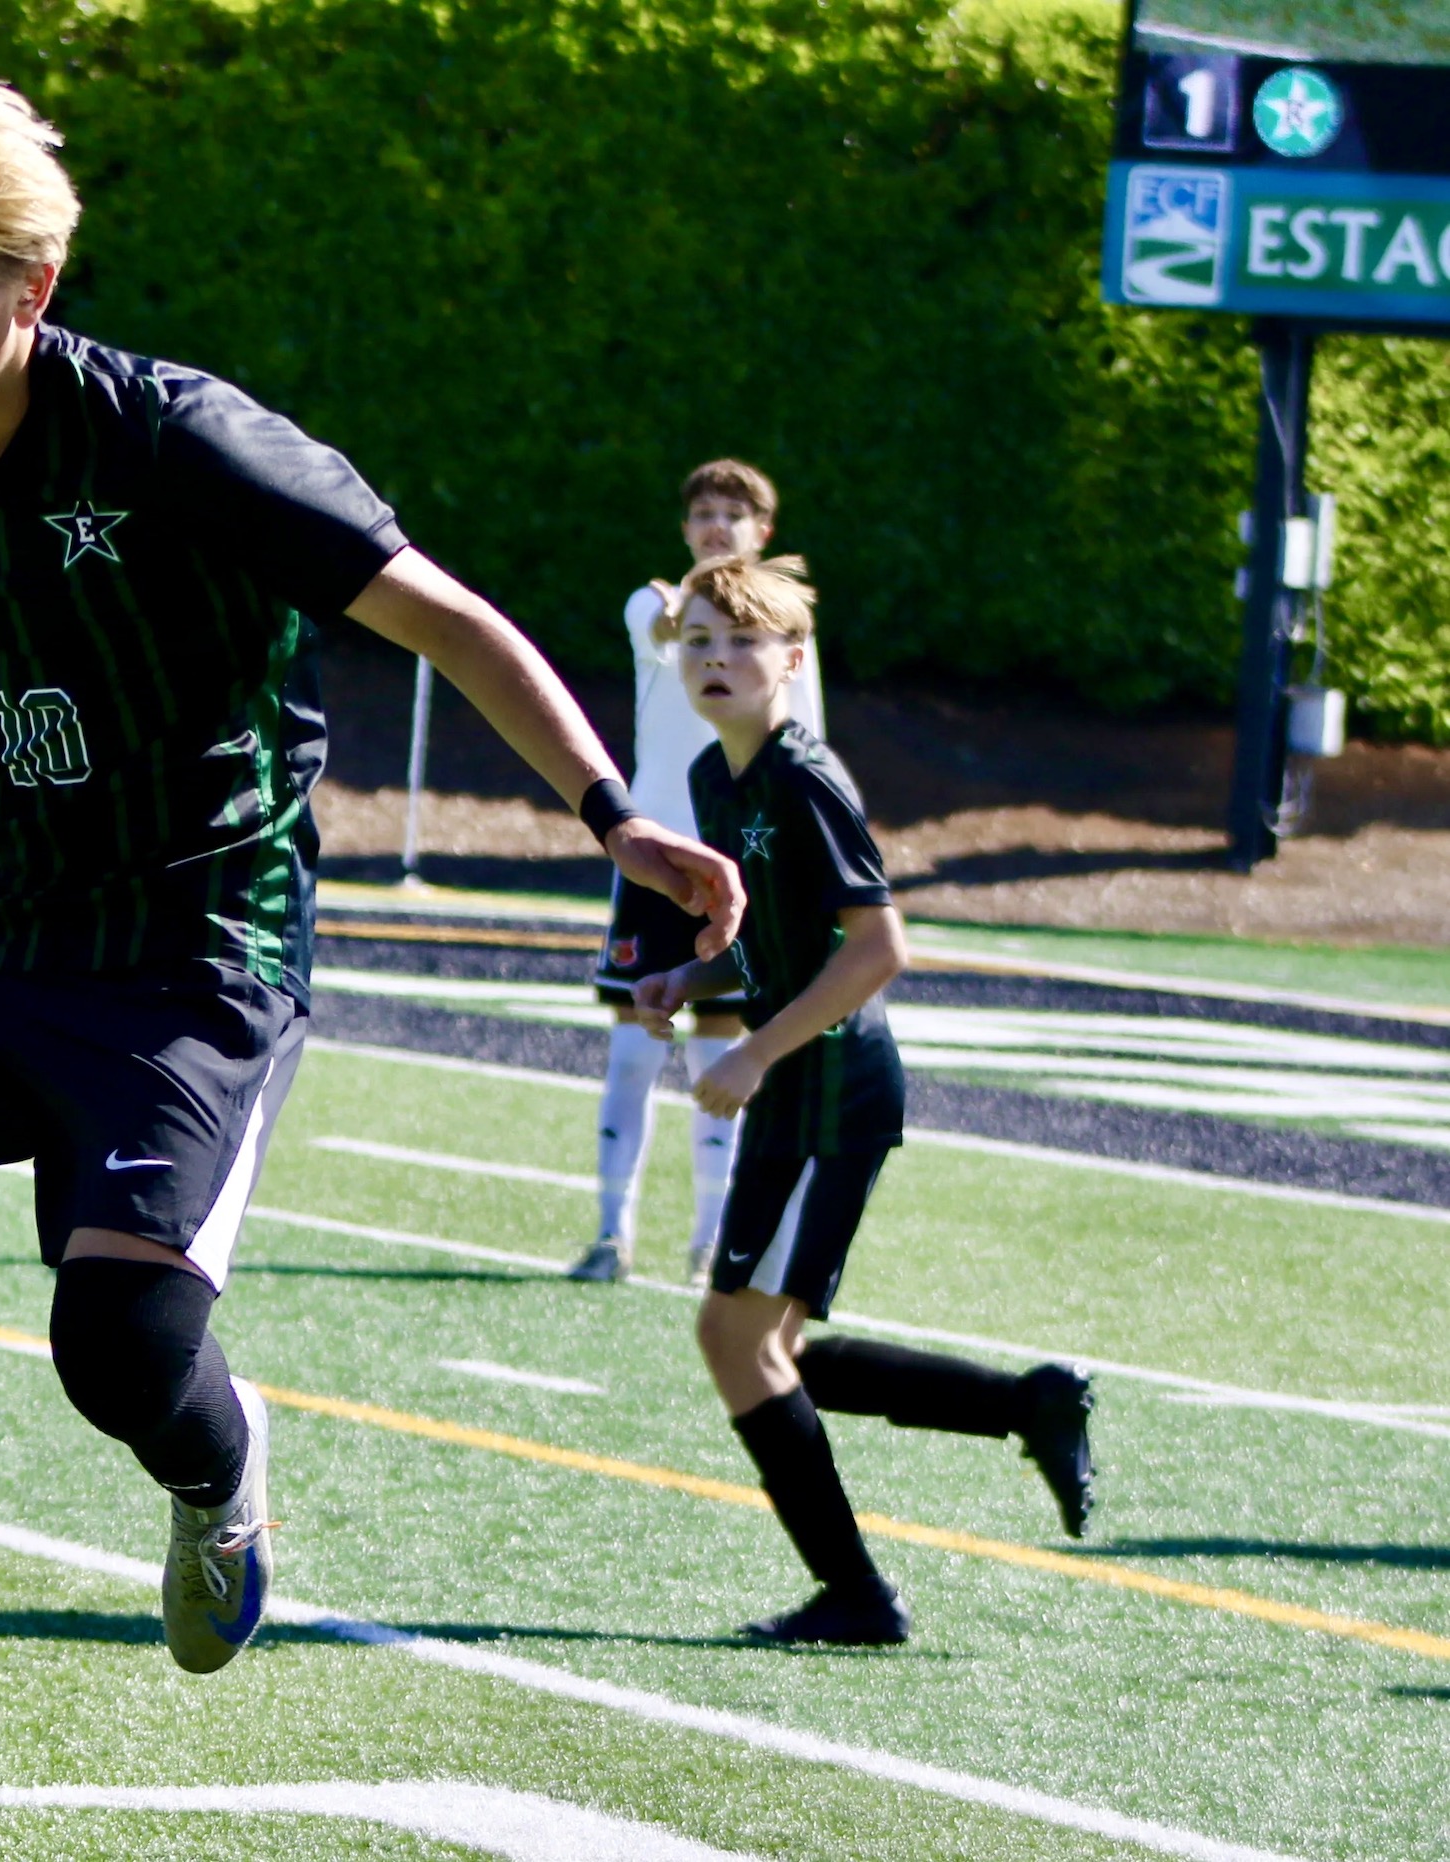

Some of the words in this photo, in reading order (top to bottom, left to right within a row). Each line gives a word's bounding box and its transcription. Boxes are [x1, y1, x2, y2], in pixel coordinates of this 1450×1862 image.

[1178, 70, 1214, 138] 1
[1133, 178, 1216, 214] ECF
[76, 516, 96, 543] E
